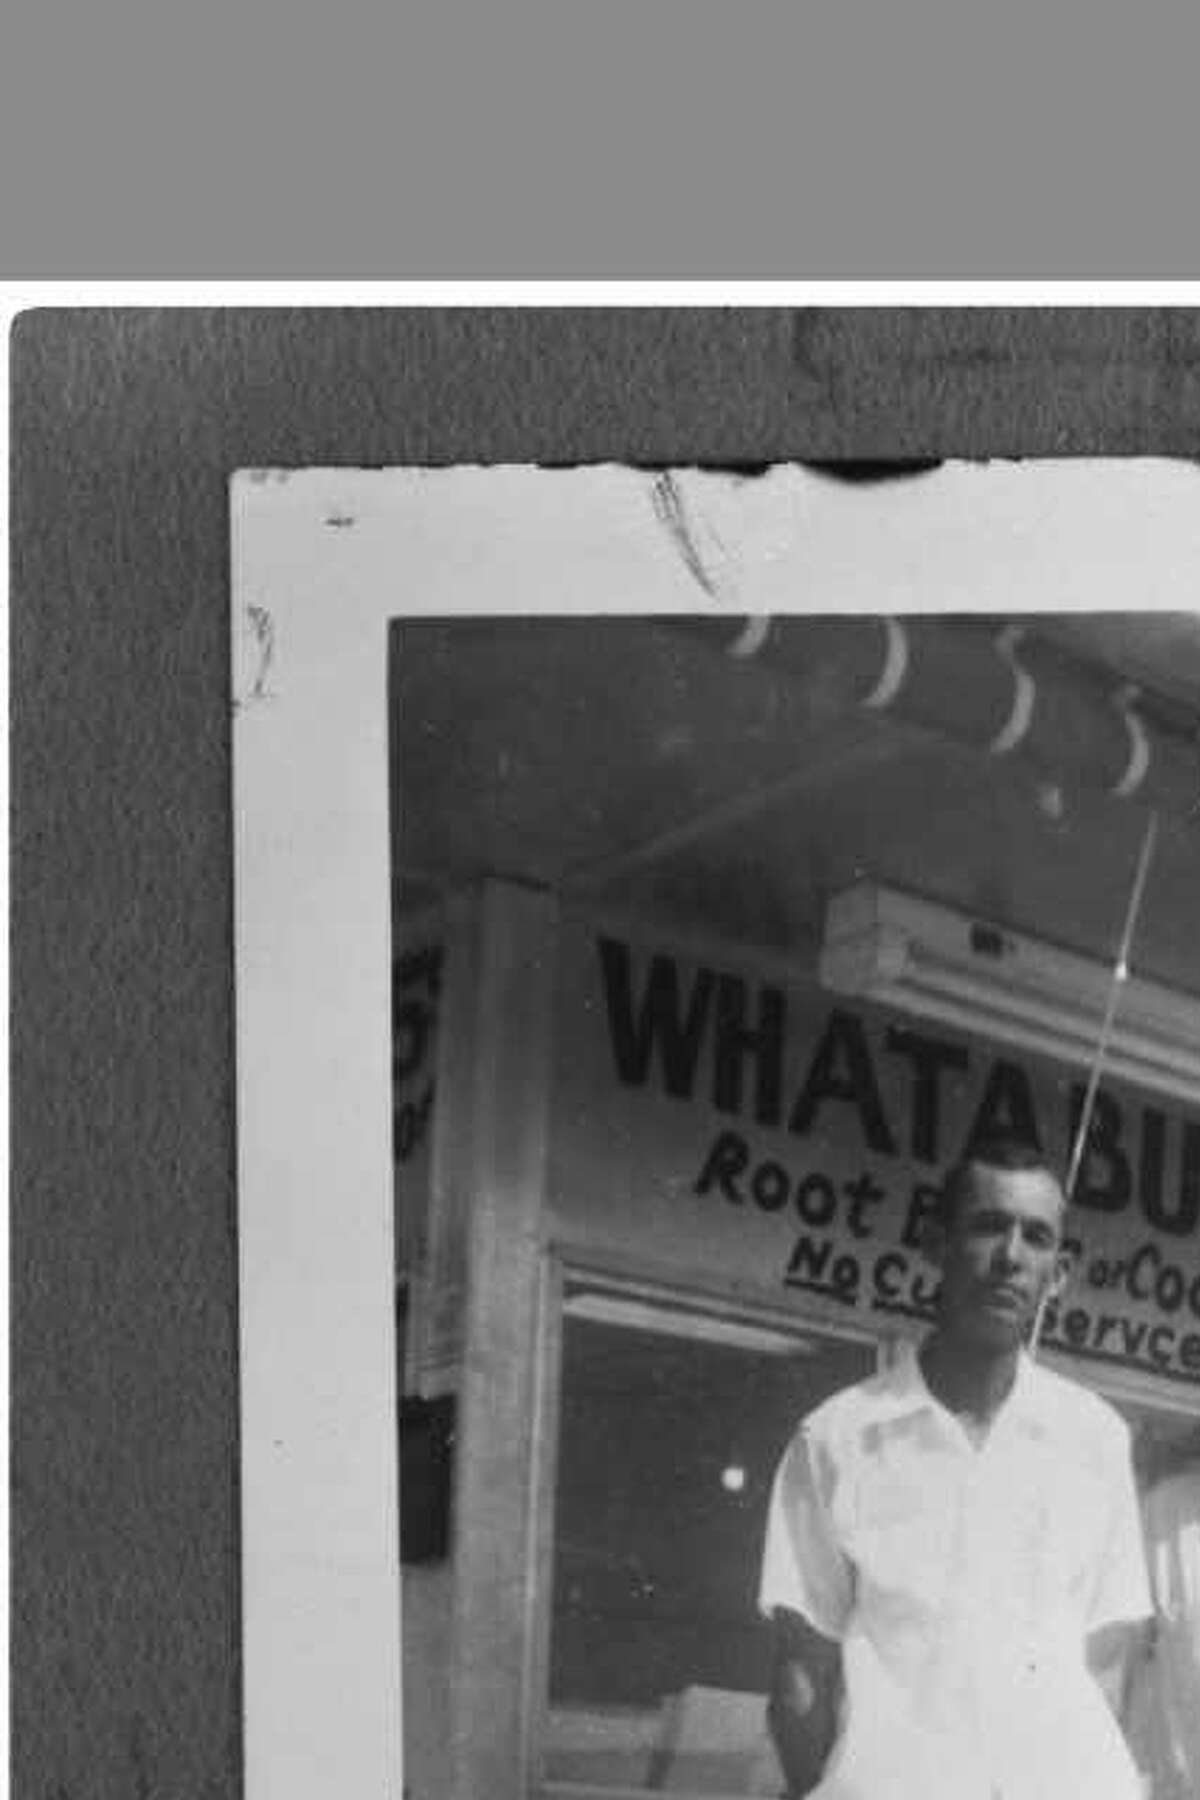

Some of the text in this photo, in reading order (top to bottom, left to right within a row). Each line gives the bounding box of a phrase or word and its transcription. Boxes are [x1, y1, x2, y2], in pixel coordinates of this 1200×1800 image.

[692, 1128, 885, 1240] Root
[786, 1234, 861, 1306] No
[872, 1251, 945, 1322] Cu
